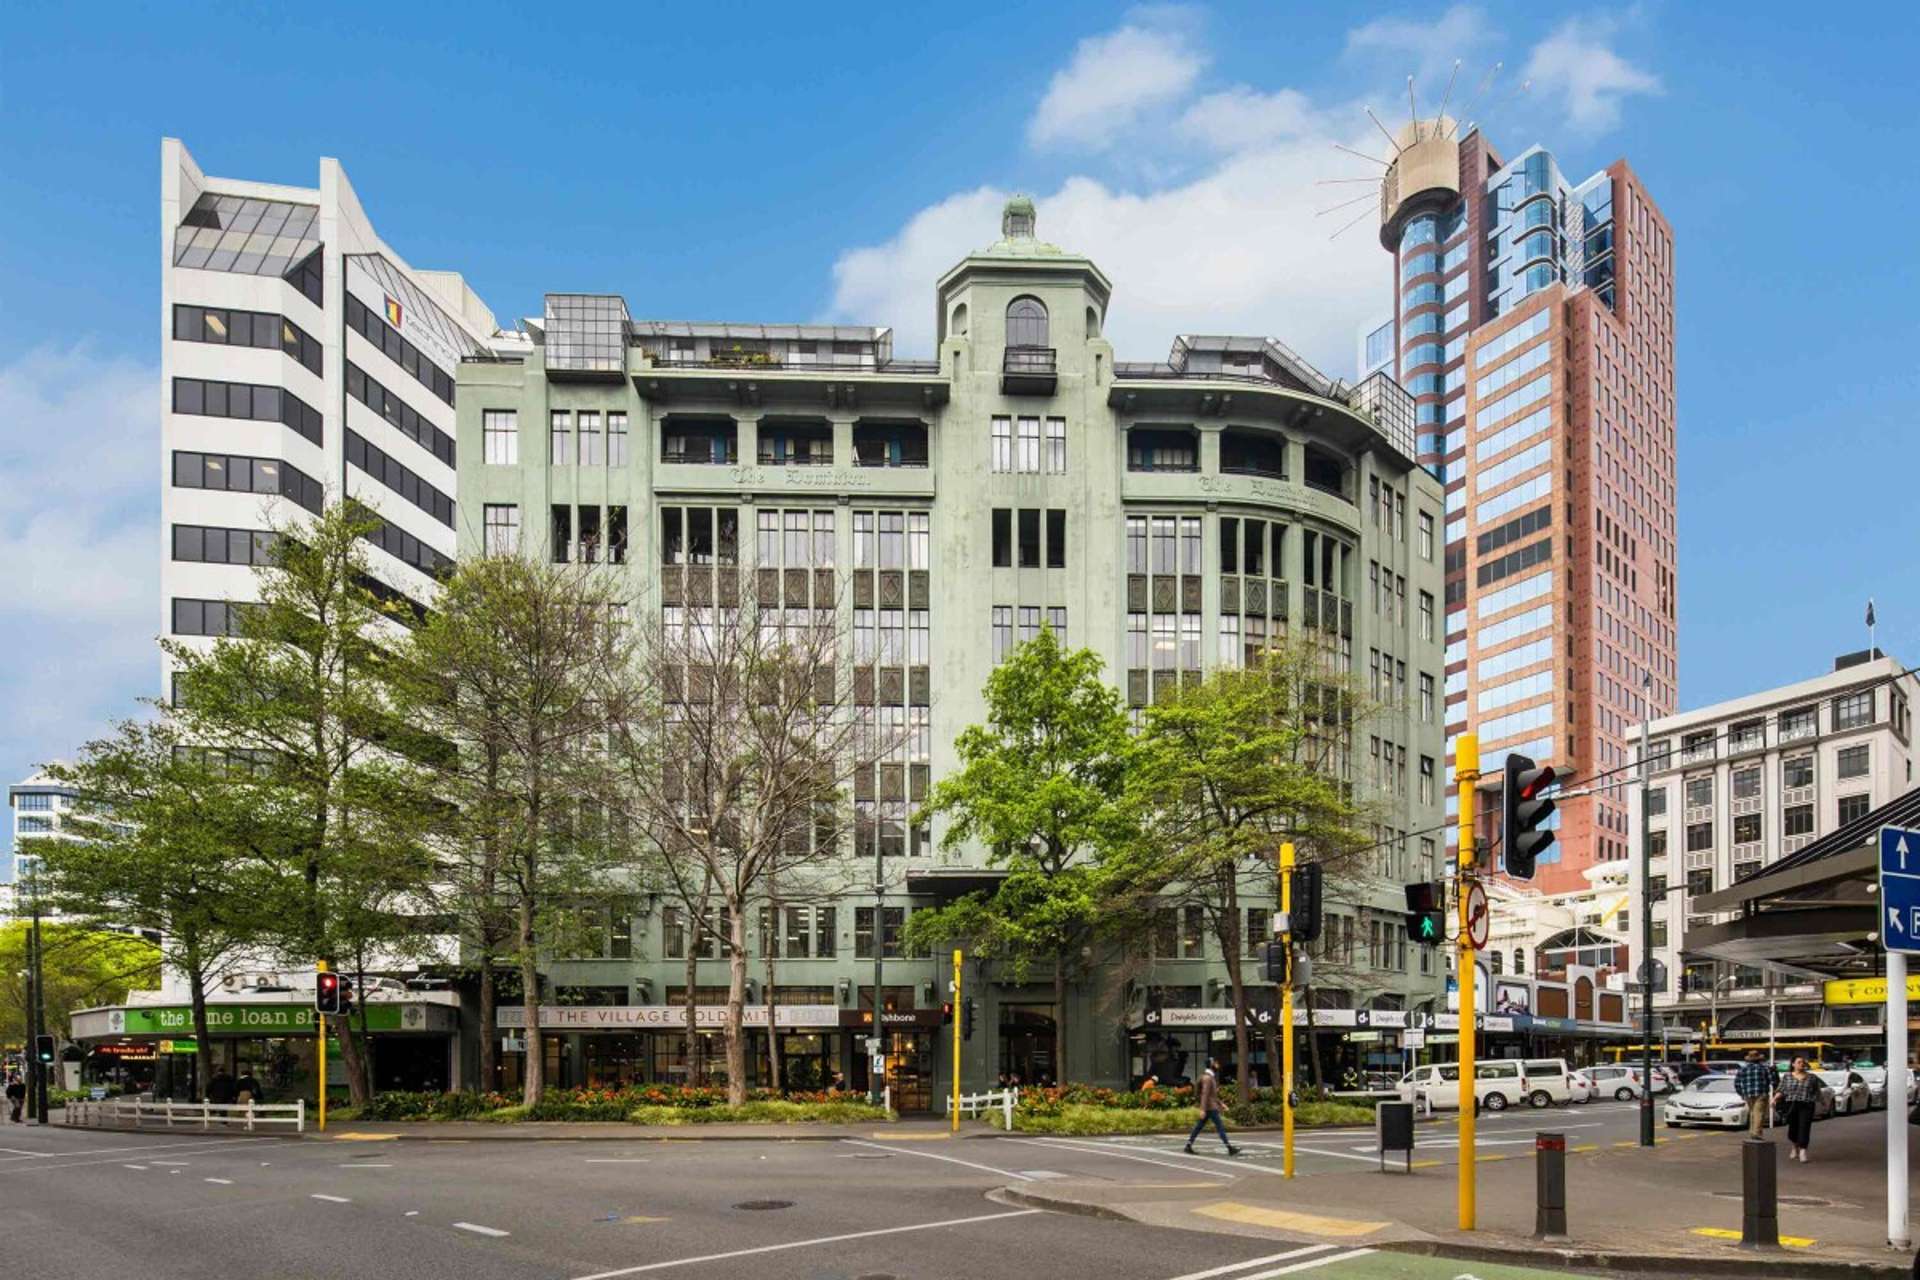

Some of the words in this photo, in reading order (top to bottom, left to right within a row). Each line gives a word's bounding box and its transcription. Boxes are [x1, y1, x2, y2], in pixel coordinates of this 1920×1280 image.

[160, 1010, 185, 1026] the
[241, 1008, 289, 1025] loan
[557, 1010, 589, 1023] THE
[598, 1010, 670, 1023] VILLAGE
